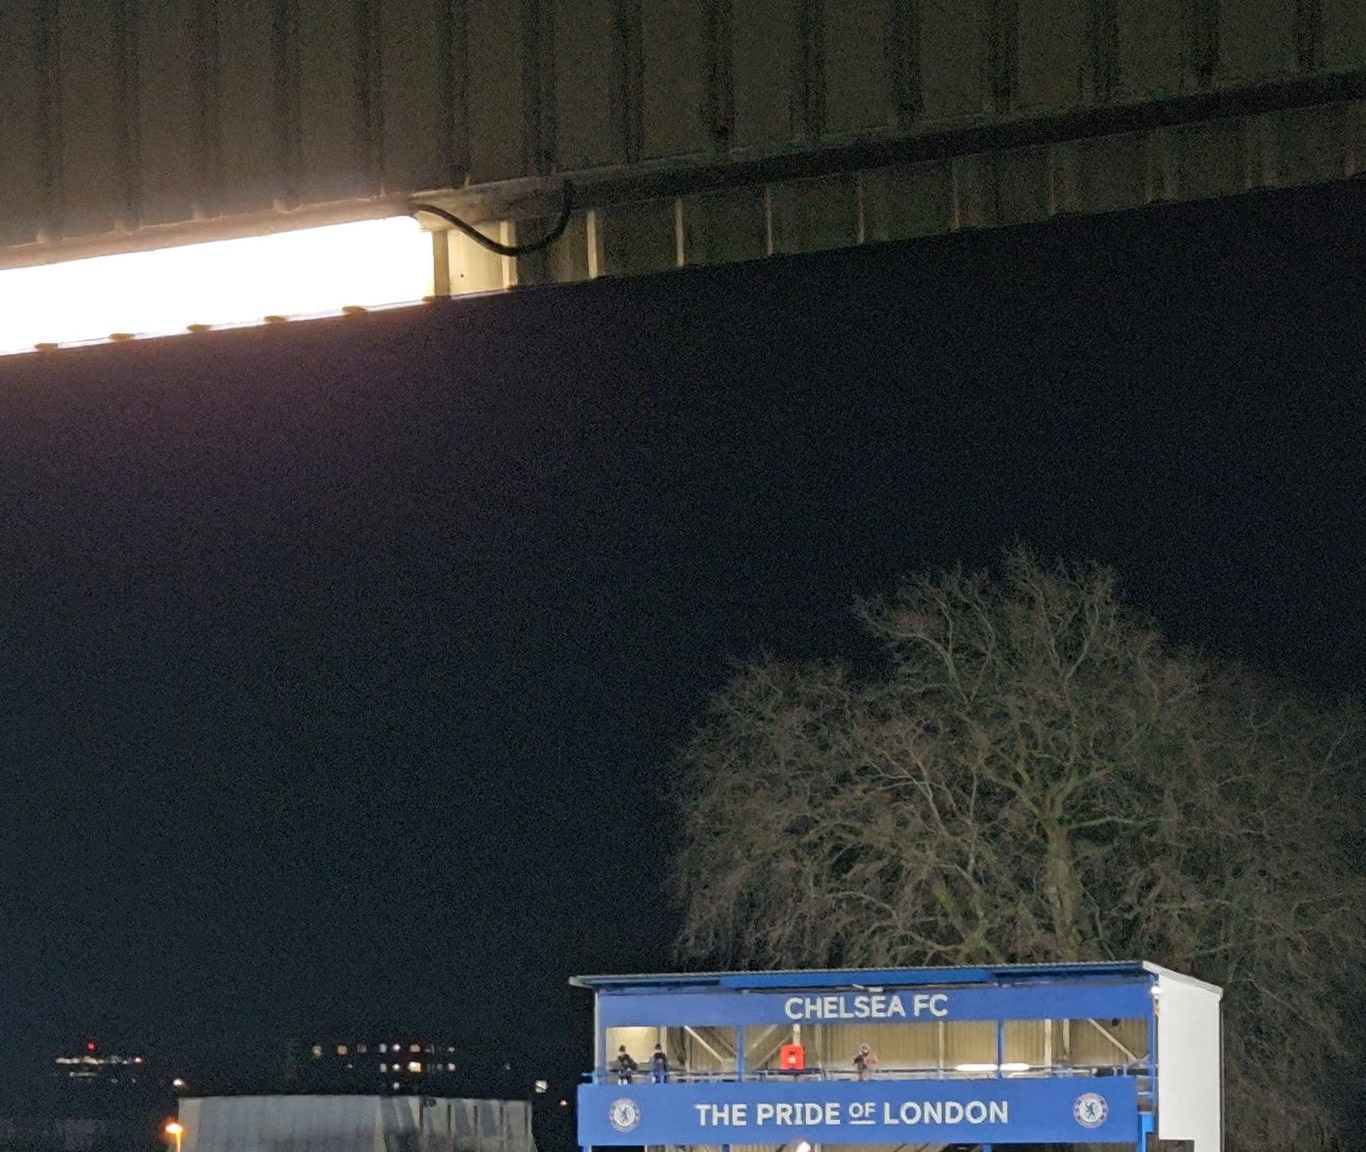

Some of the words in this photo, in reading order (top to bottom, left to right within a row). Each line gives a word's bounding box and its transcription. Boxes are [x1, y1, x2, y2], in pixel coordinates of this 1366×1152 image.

[785, 995, 906, 1020] CHELSEA
[914, 994, 948, 1017] FC
[695, 1104, 747, 1126] THE
[757, 1103, 841, 1125] PRIDE
[849, 1103, 875, 1118] OF
[884, 1101, 1008, 1125] LONDON
